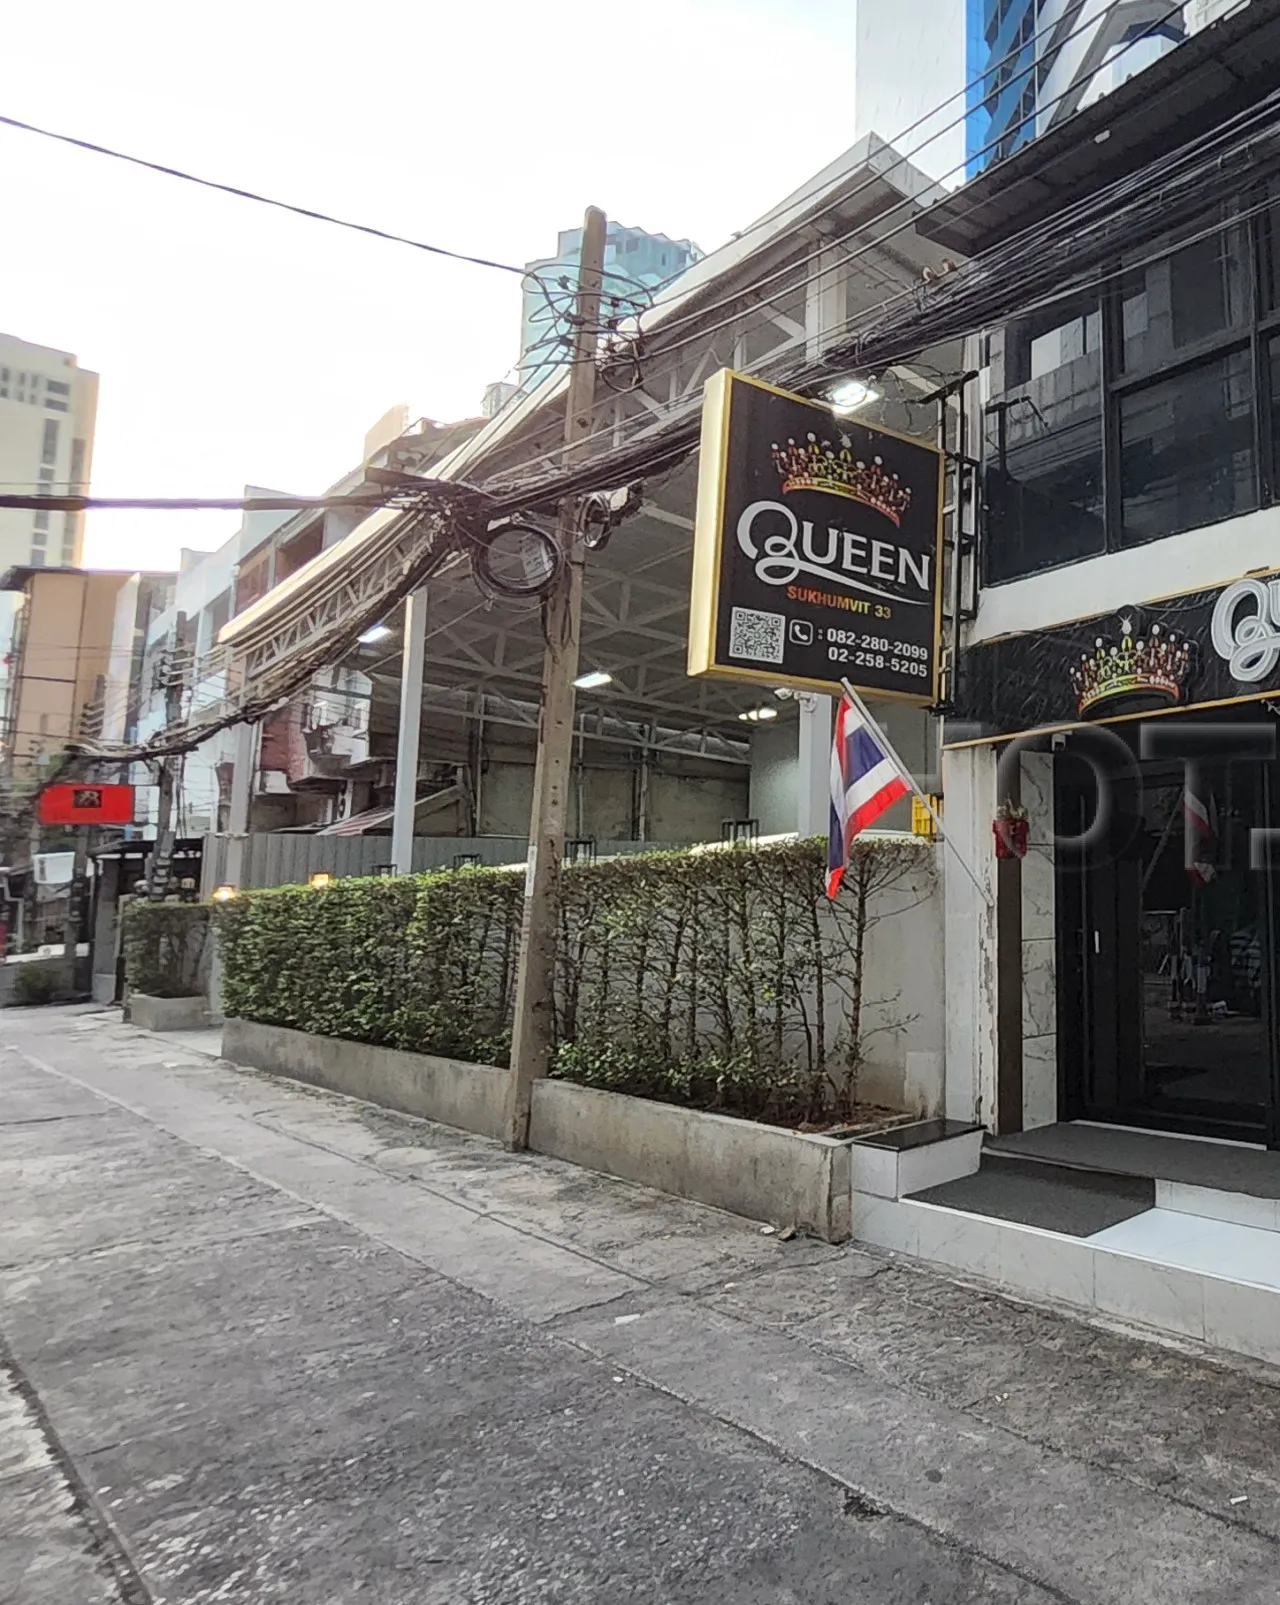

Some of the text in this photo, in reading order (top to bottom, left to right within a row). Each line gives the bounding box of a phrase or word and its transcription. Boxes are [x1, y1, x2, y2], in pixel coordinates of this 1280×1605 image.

[736, 500, 931, 606] QUEEN
[786, 585, 892, 619] SUKHUMVIT 33
[826, 627, 928, 661] 082-280-2099
[827, 647, 928, 678] 02-258-5205
